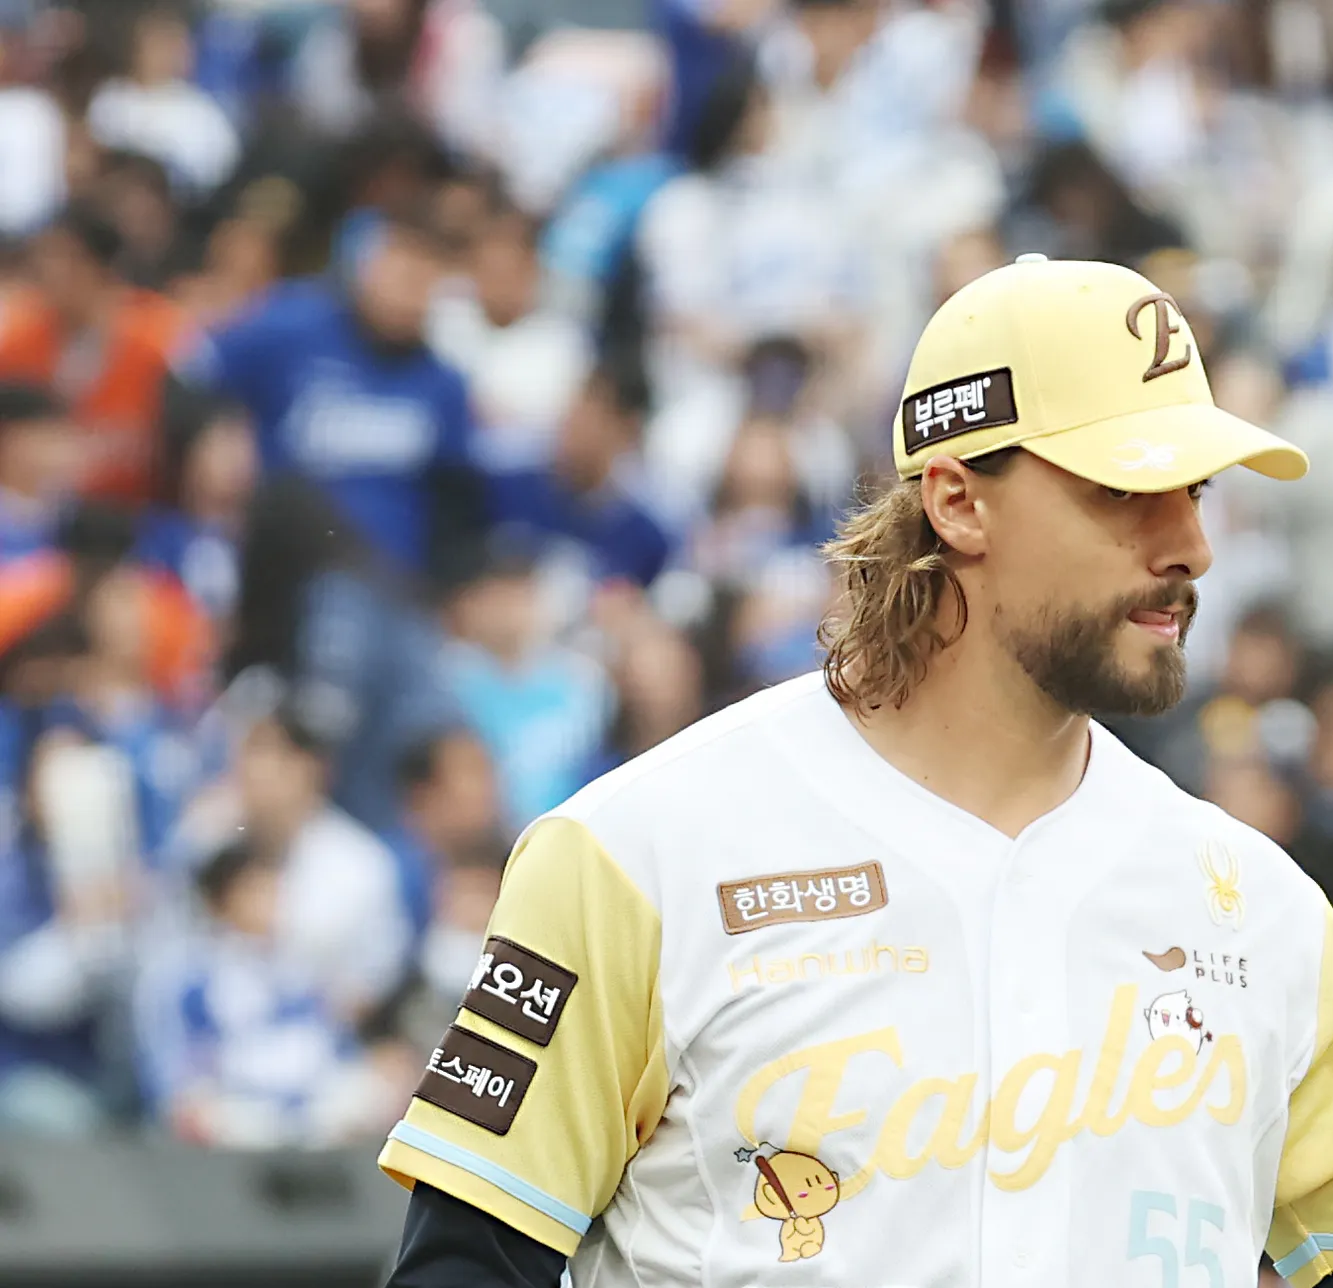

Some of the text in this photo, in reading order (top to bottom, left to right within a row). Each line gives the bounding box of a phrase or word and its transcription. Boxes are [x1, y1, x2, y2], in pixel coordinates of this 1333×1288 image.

[914, 379, 989, 438] 부루펜
[732, 872, 872, 921] 한화생명
[727, 939, 930, 993] Hanwha
[1193, 949, 1249, 972] LIFE
[1195, 966, 1248, 989] PLUS
[735, 983, 1249, 1222] Eagles
